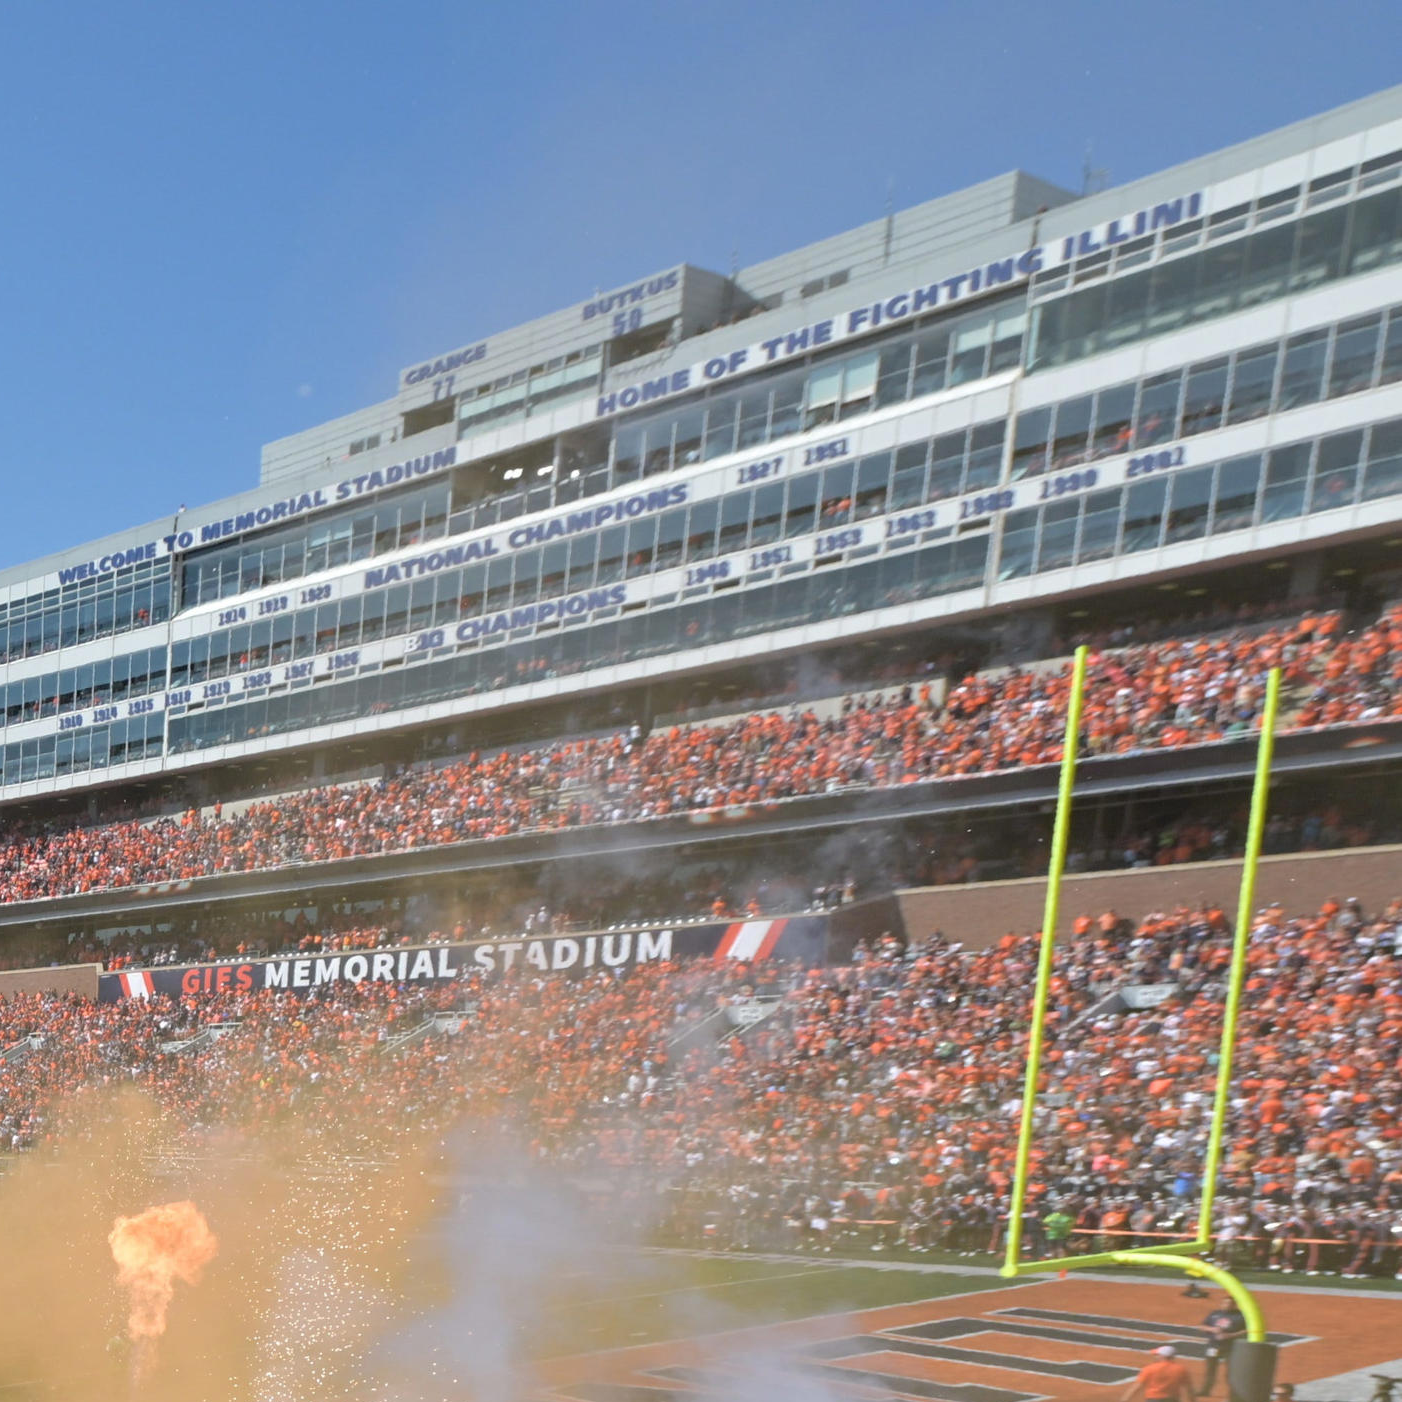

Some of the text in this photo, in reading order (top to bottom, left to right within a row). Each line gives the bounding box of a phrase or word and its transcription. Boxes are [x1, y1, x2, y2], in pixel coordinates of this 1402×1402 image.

[582, 270, 679, 321] BUTKUS
[596, 192, 1201, 417] HOME OF THE FIGHTING ILLINI
[612, 308, 643, 337] 50
[404, 343, 487, 385] GRANGE
[432, 375, 456, 401] 77
[58, 446, 457, 585] WELCOME TO MEMORIAL STADIUM
[364, 538, 498, 588] NATIONAL
[508, 483, 688, 549] CHAMPIONS
[456, 585, 628, 642] CHAMPIONS
[181, 930, 674, 995] GIES MEMORIAL STADIUM
